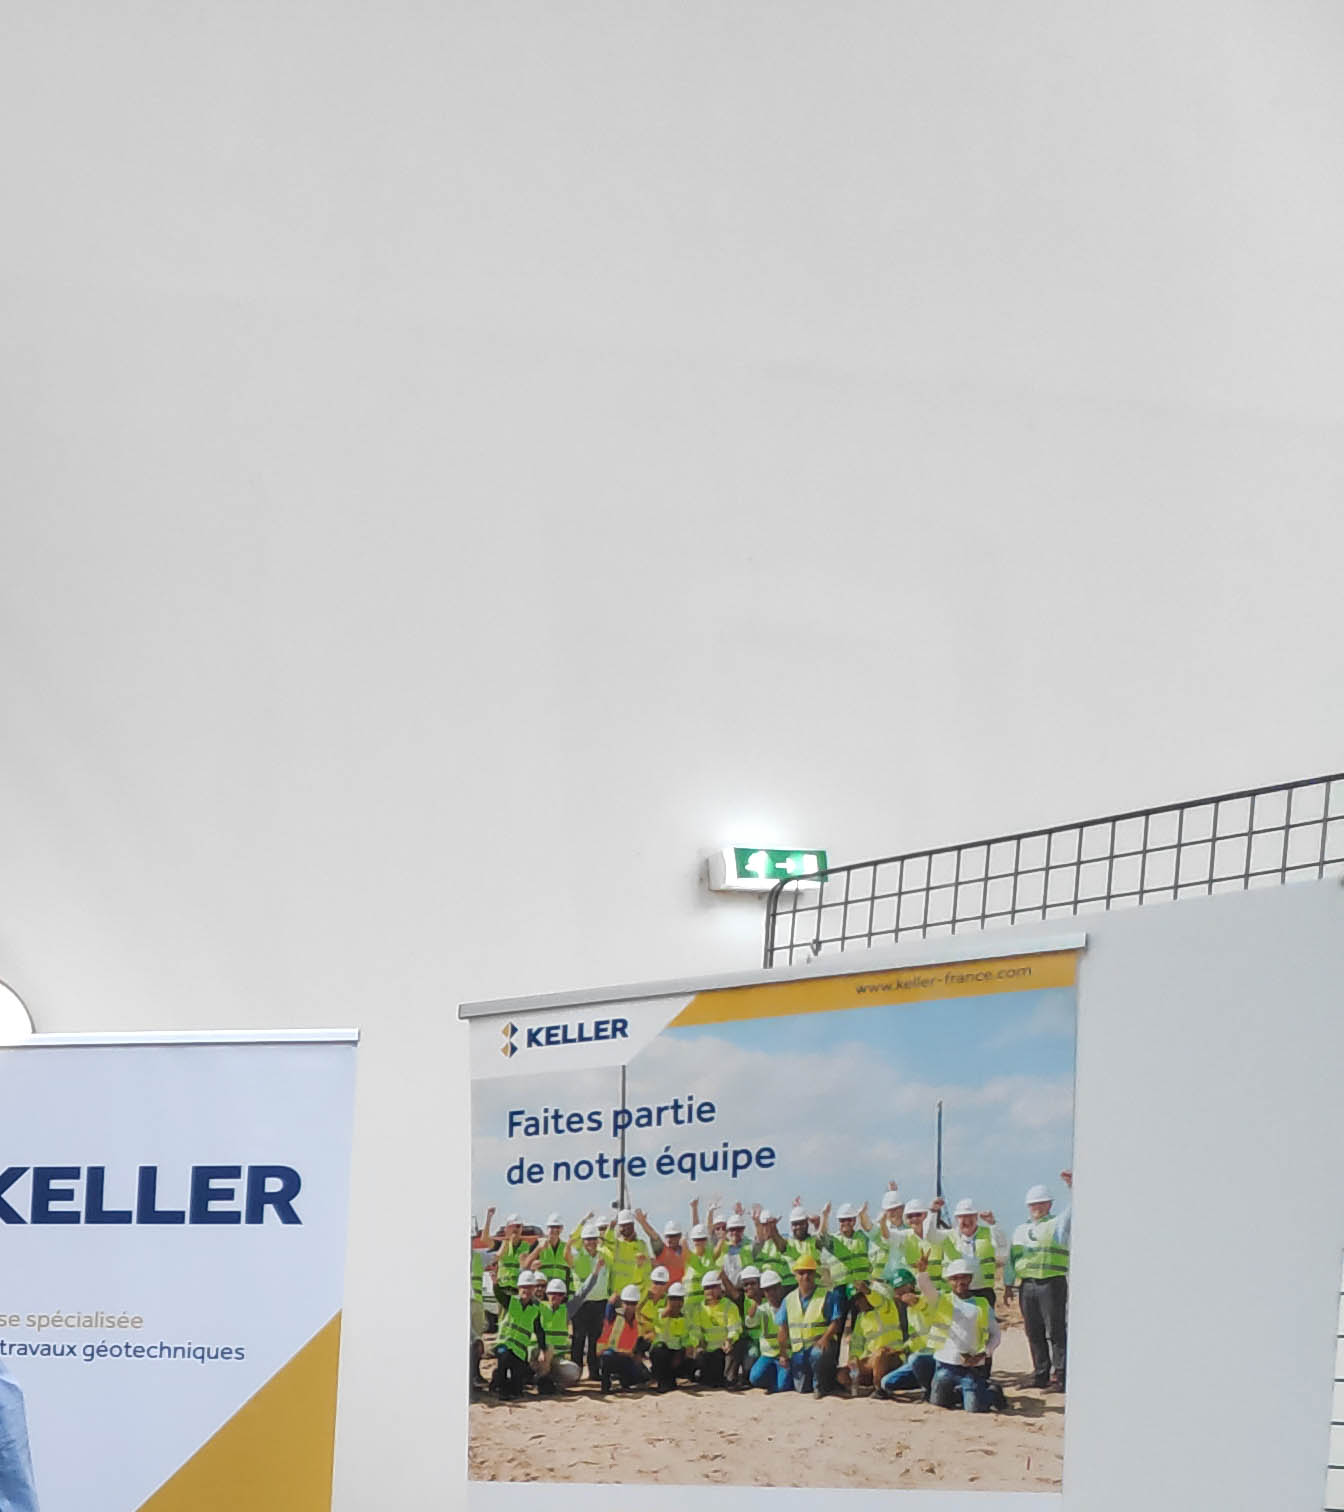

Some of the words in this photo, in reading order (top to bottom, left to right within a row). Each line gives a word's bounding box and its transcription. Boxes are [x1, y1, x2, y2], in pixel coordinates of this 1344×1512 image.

[855, 964, 1033, 996] www.keller-france.com
[525, 1017, 629, 1048] KELLER
[507, 1103, 604, 1139] Faites
[611, 1095, 717, 1132] partie
[505, 1155, 544, 1186] de
[552, 1150, 647, 1184] notre
[656, 1140, 778, 1181] équipe
[26, 1310, 144, 1333] spécialisée
[0, 1340, 77, 1357] travaux
[83, 1340, 246, 1364] géotechniques
